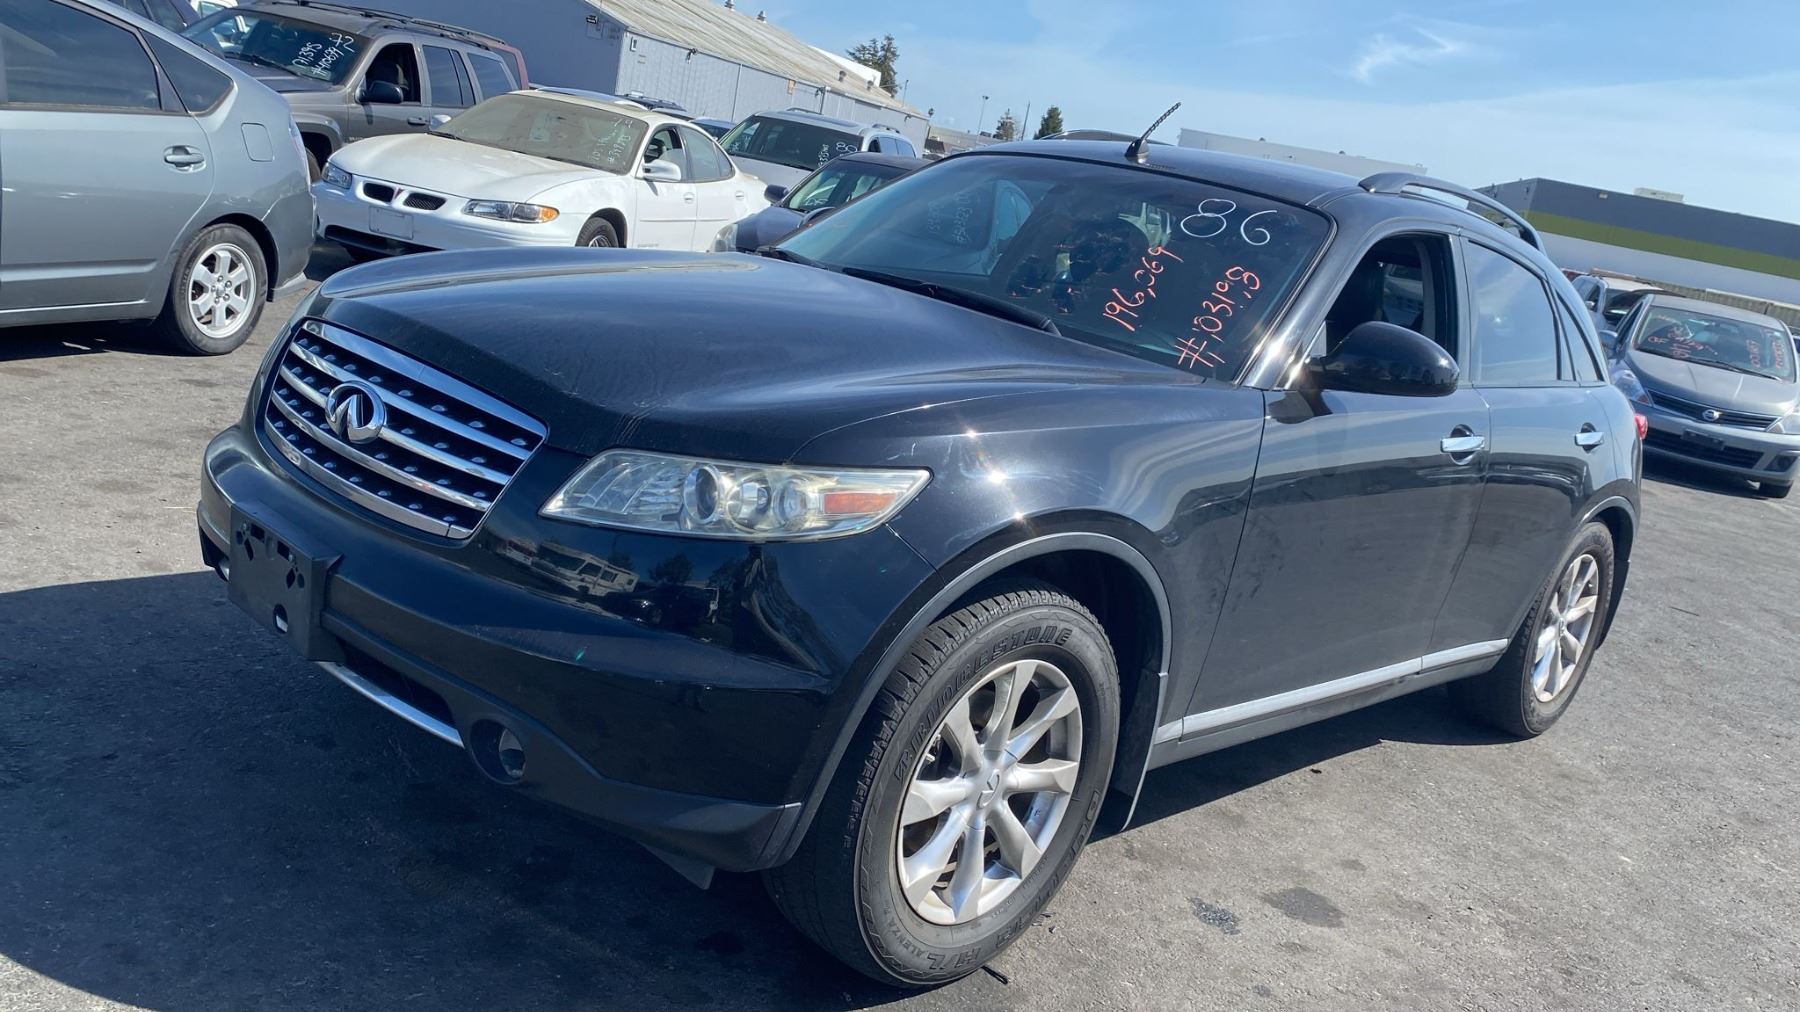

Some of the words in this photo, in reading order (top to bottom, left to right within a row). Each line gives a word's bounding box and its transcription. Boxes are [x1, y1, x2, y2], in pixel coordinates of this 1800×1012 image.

[1181, 198, 1277, 245] 86
[894, 625, 1073, 782] BRIDGESTONE
[886, 919, 928, 958] ALENZA
